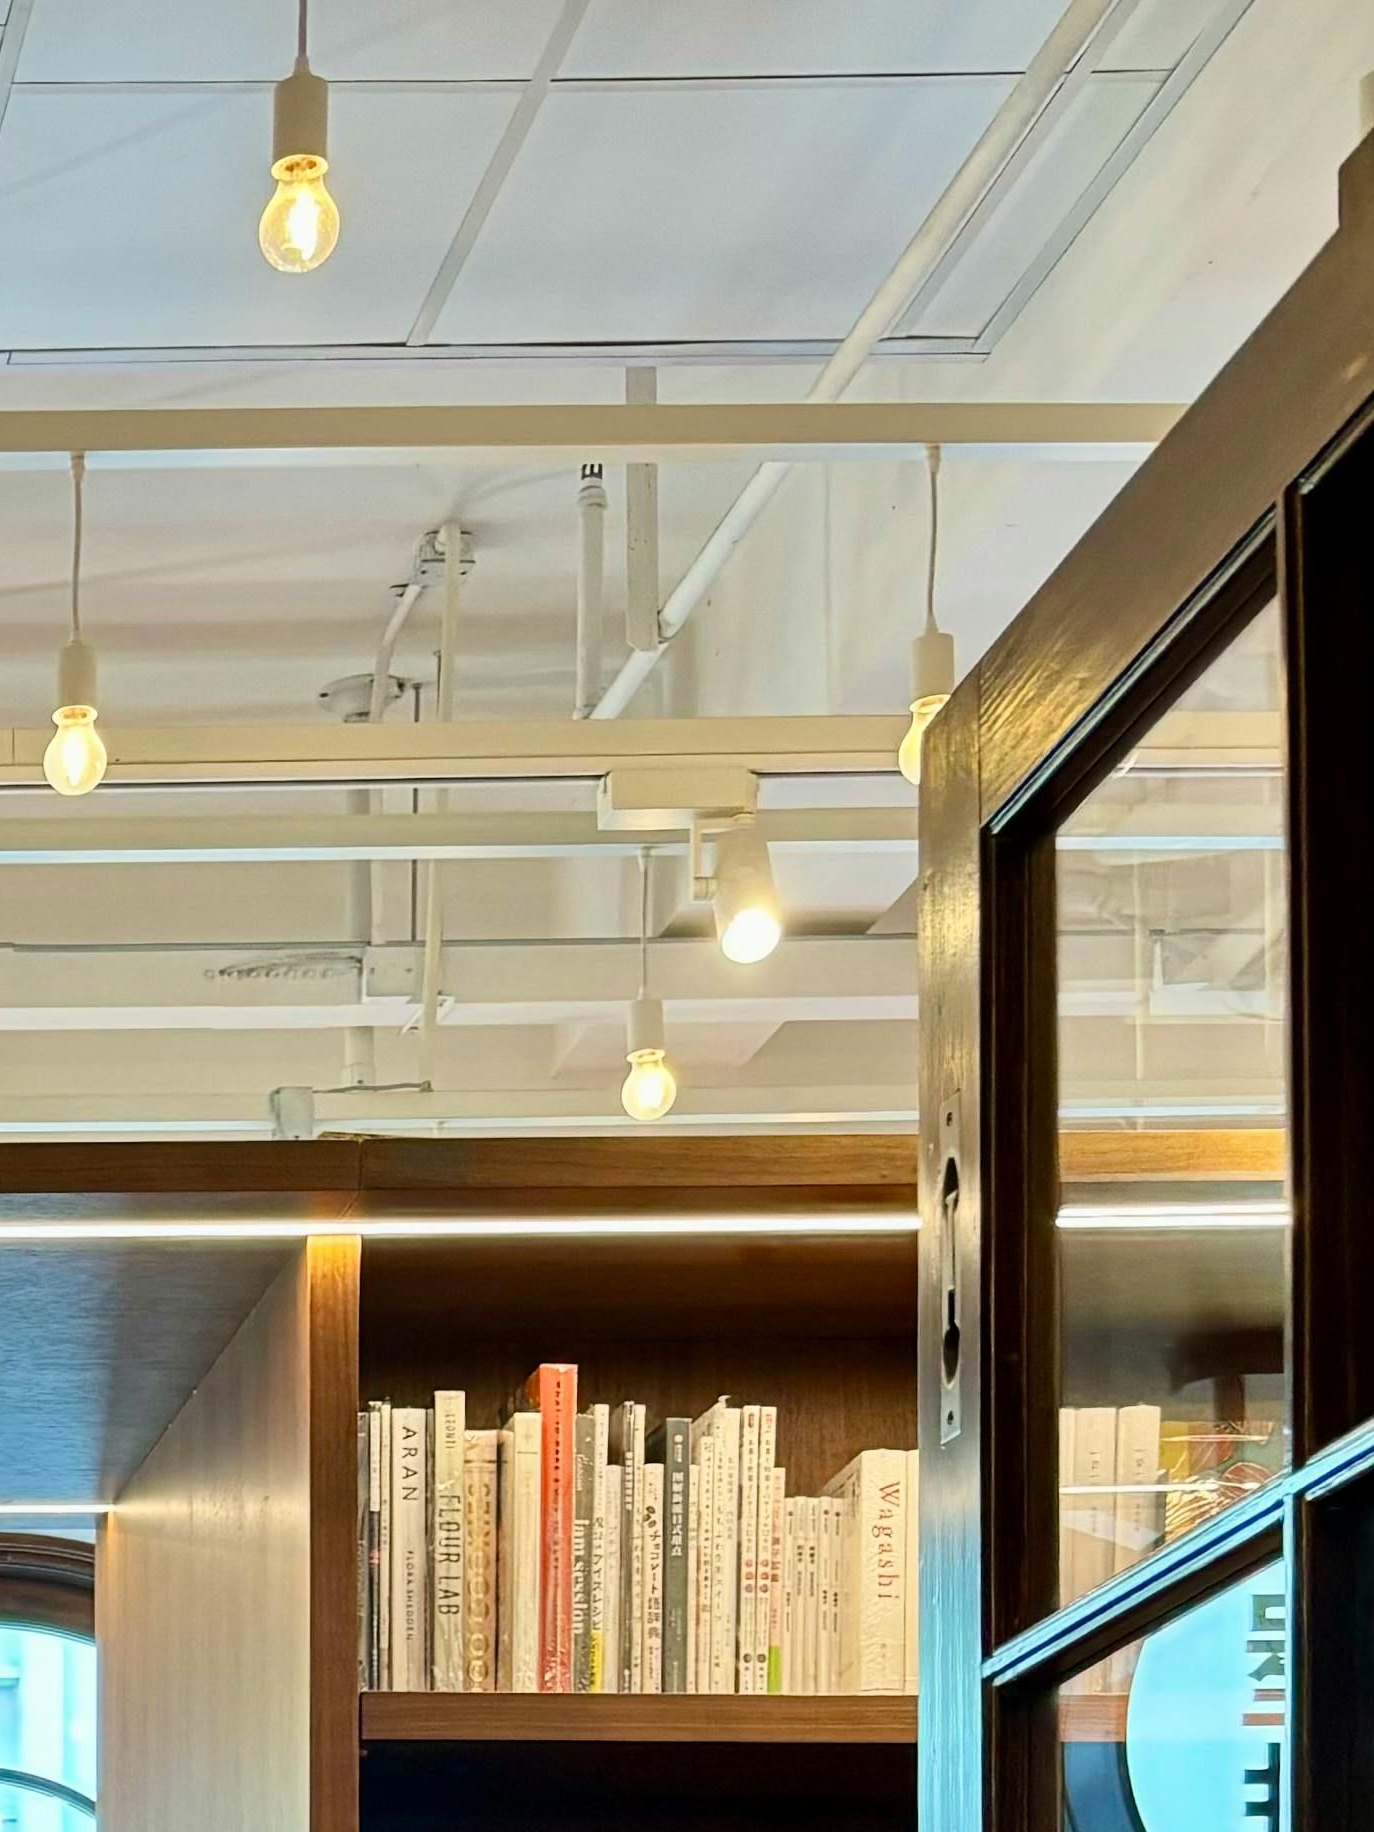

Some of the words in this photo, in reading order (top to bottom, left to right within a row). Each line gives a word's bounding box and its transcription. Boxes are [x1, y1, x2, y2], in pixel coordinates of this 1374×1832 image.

[401, 1426, 418, 1502] ARAN
[437, 1494, 461, 1564] FLOUR
[872, 1481, 901, 1600] Wagashi
[438, 1575, 460, 1615] LAB
